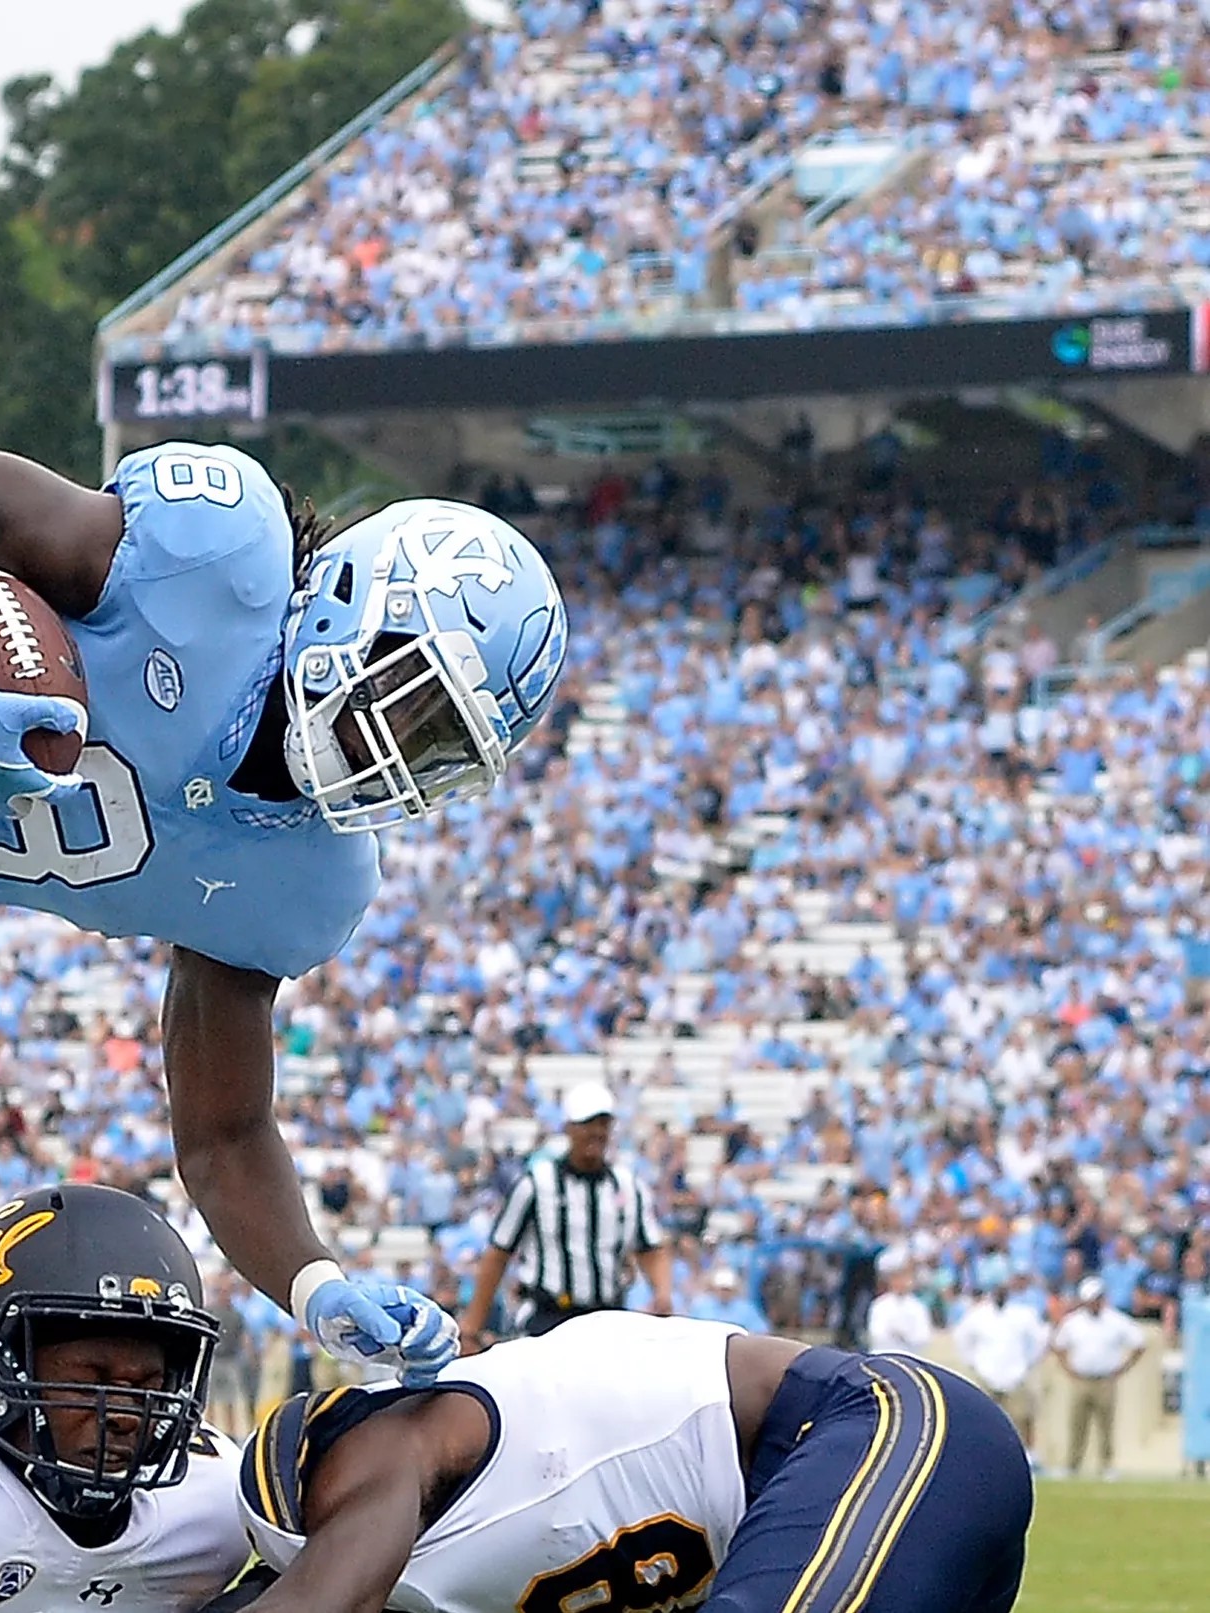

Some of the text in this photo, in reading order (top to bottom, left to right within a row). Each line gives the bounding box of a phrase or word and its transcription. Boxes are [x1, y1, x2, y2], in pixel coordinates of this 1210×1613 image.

[137, 365, 226, 416] 1:38
[152, 453, 243, 508] 8
[151, 654, 179, 701] ACC
